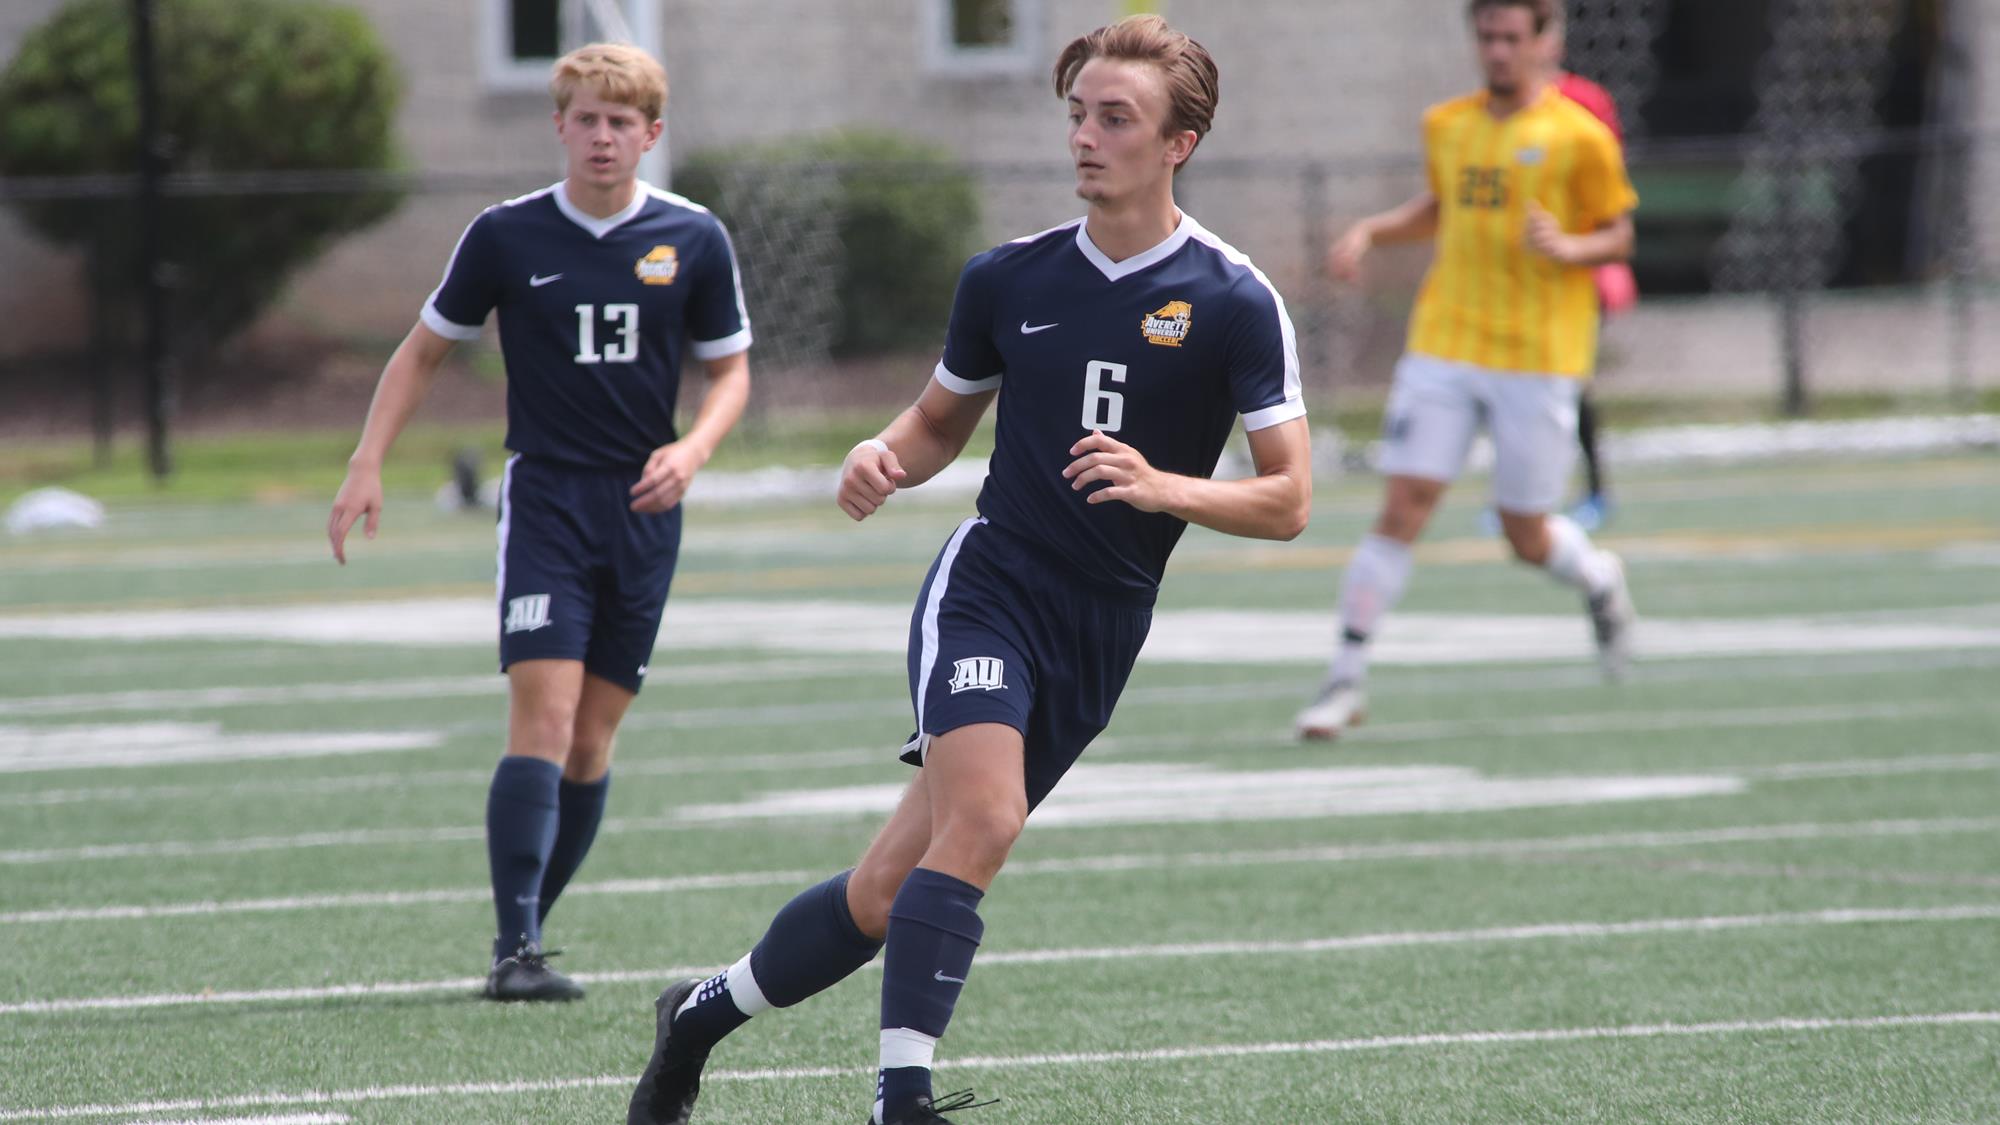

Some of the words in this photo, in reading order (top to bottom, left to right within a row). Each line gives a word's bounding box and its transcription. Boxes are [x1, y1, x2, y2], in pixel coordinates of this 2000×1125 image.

[1459, 167, 1509, 208] 25
[574, 304, 639, 363] 13
[1145, 316, 1187, 331] AVERETT
[1081, 360, 1127, 432] 6
[506, 596, 547, 631] AU
[954, 659, 1001, 690] AU
